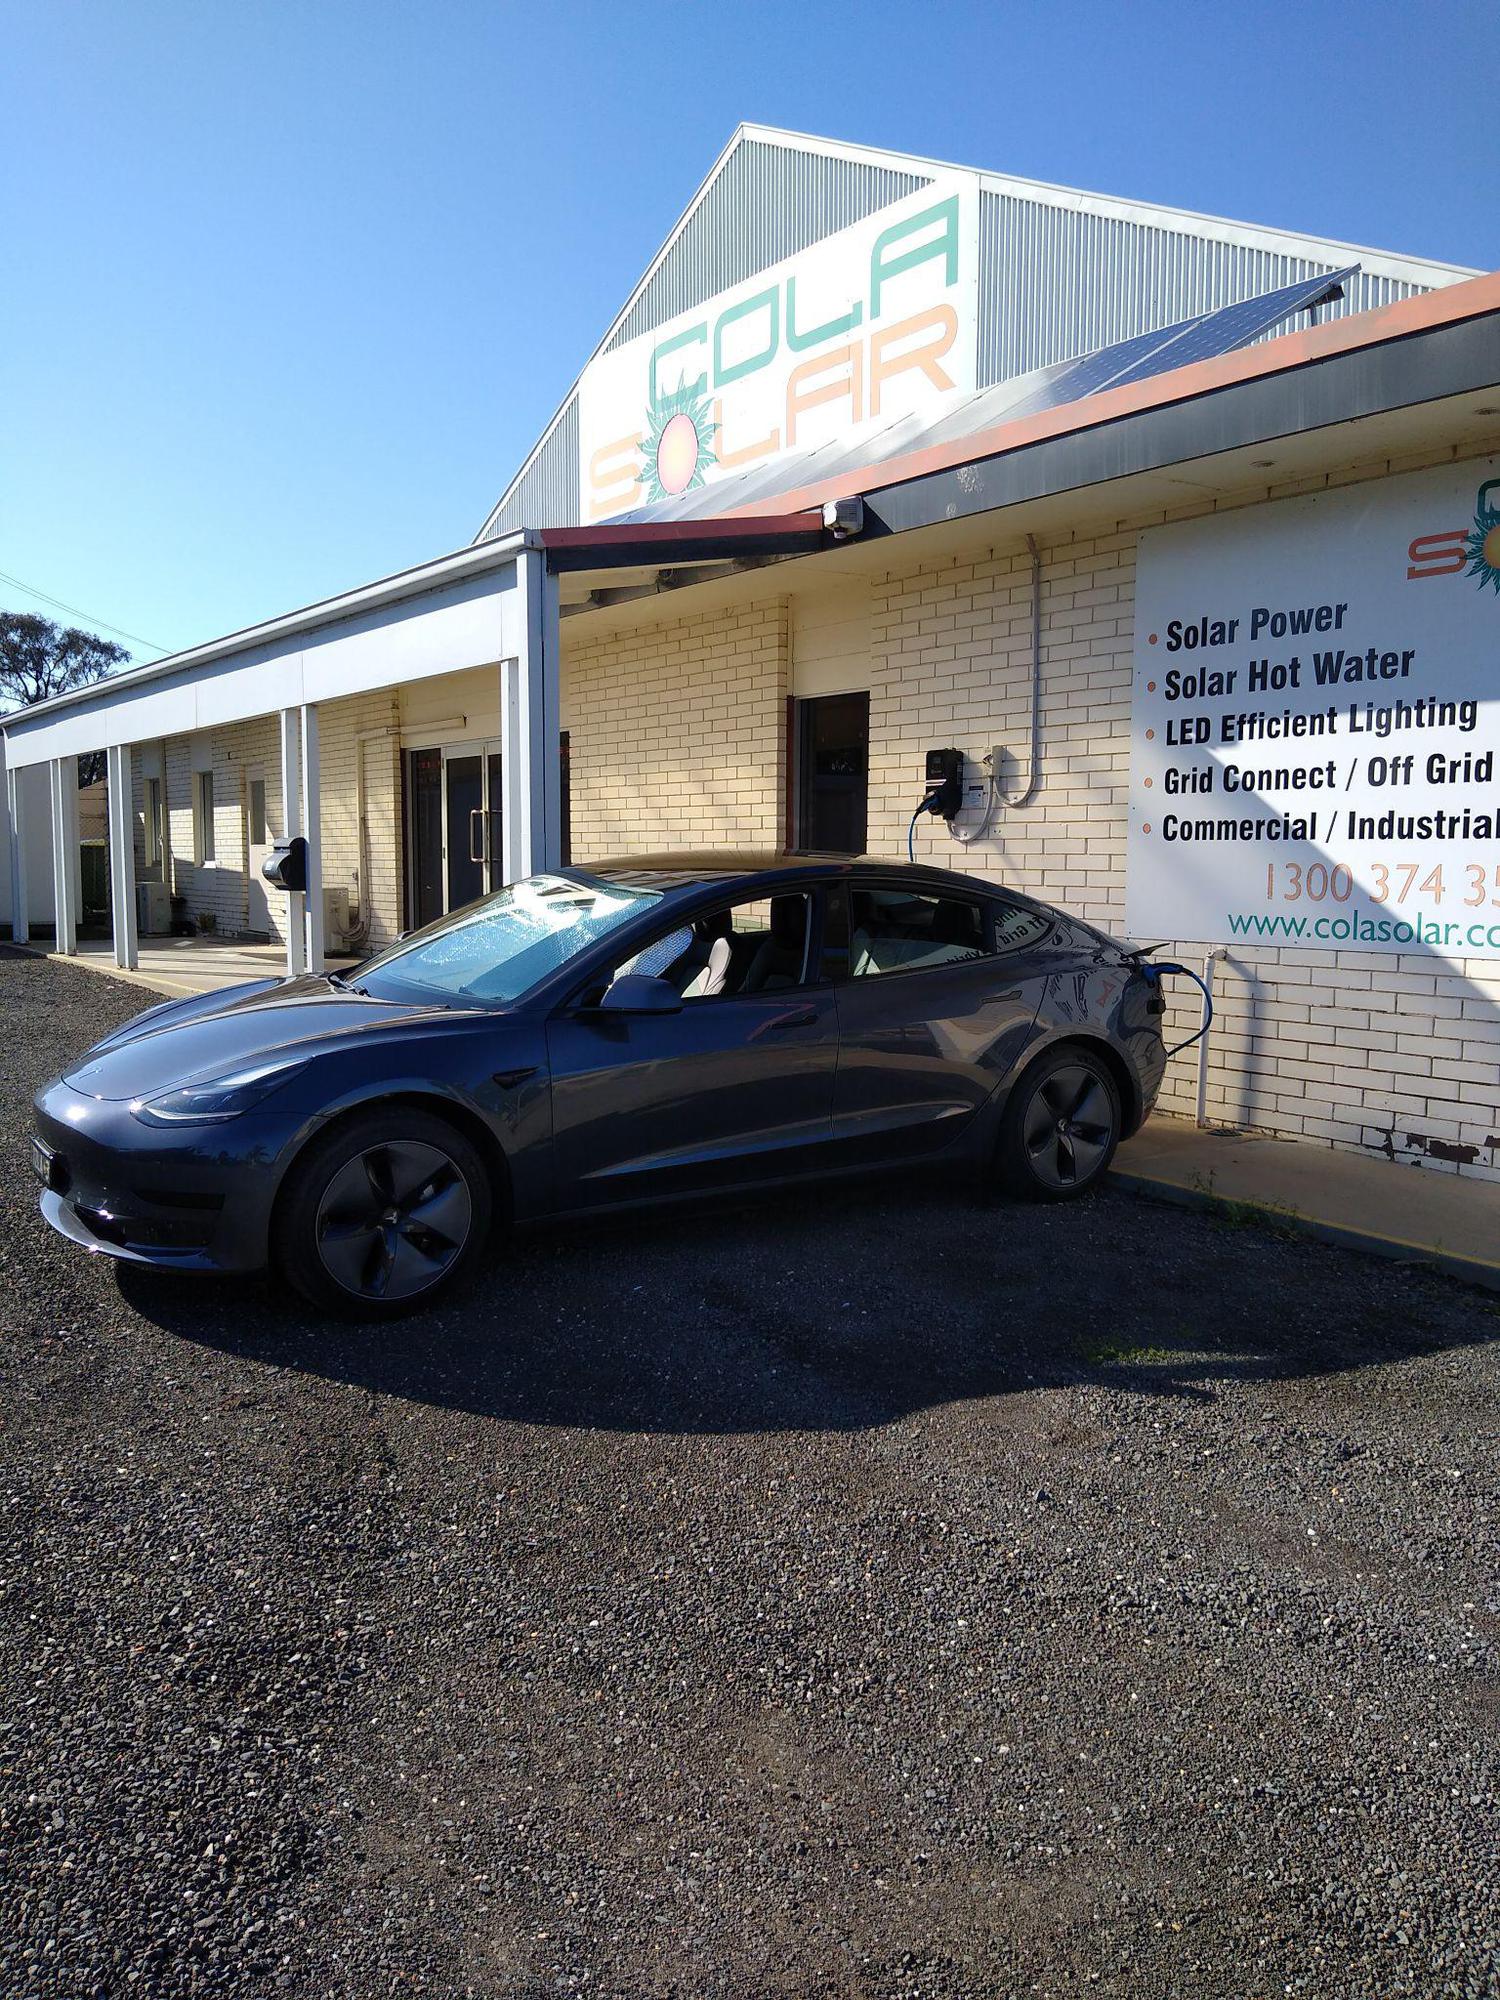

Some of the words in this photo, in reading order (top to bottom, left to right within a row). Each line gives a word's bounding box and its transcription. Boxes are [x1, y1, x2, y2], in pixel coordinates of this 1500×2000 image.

[649, 193, 960, 412] COLA
[1167, 616, 1239, 652] Solar
[1251, 603, 1348, 640] Power
[1165, 667, 1237, 701] Solar
[1249, 657, 1301, 692] Hot
[1313, 648, 1415, 685] Water
[1166, 717, 1211, 746] LED
[1221, 704, 1338, 742] Efficient
[1349, 697, 1479, 738] Lighting
[1165, 766, 1213, 794] Grid
[1223, 761, 1337, 793] Connect
[1345, 758, 1358, 791] /
[1368, 755, 1414, 787] Off
[1426, 751, 1493, 784] Grid
[1162, 812, 1317, 842] Commercial
[1325, 811, 1337, 843] /
[1348, 808, 1500, 840] Industrial
[1267, 862, 1353, 902] 1300
[1368, 863, 1446, 905] 374
[1227, 909, 1500, 948] www.colasolar.co
